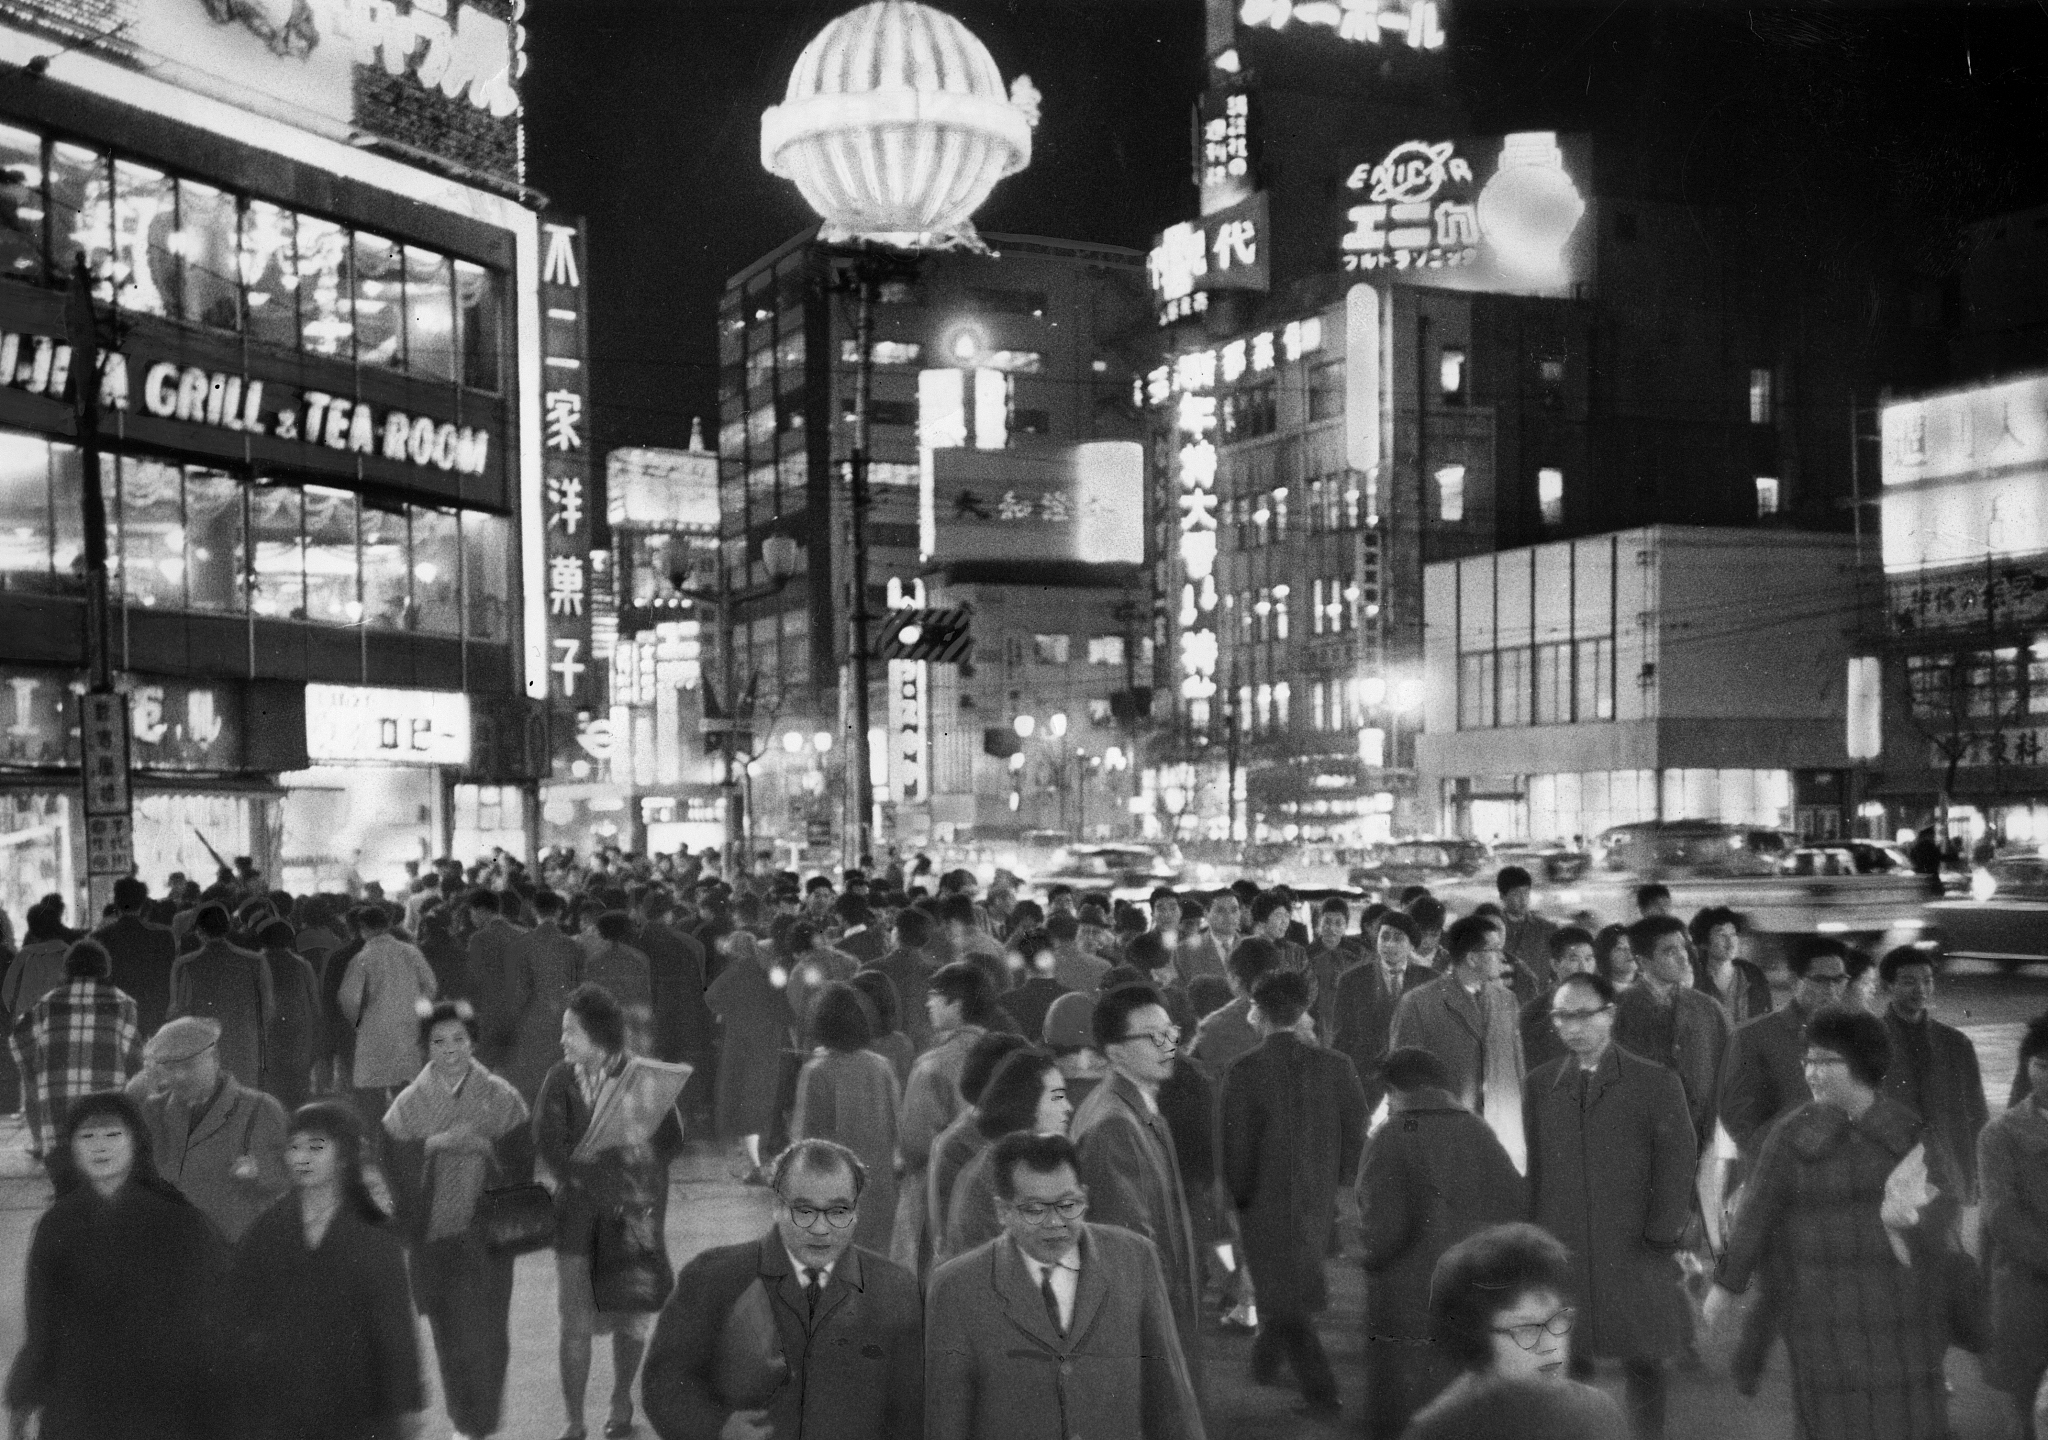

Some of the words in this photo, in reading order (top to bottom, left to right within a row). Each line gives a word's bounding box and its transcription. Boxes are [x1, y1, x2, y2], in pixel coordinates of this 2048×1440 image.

[145, 361, 266, 435] GRILL
[275, 408, 298, 440] &
[303, 391, 374, 456] TEA
[383, 410, 490, 477] ROOM
